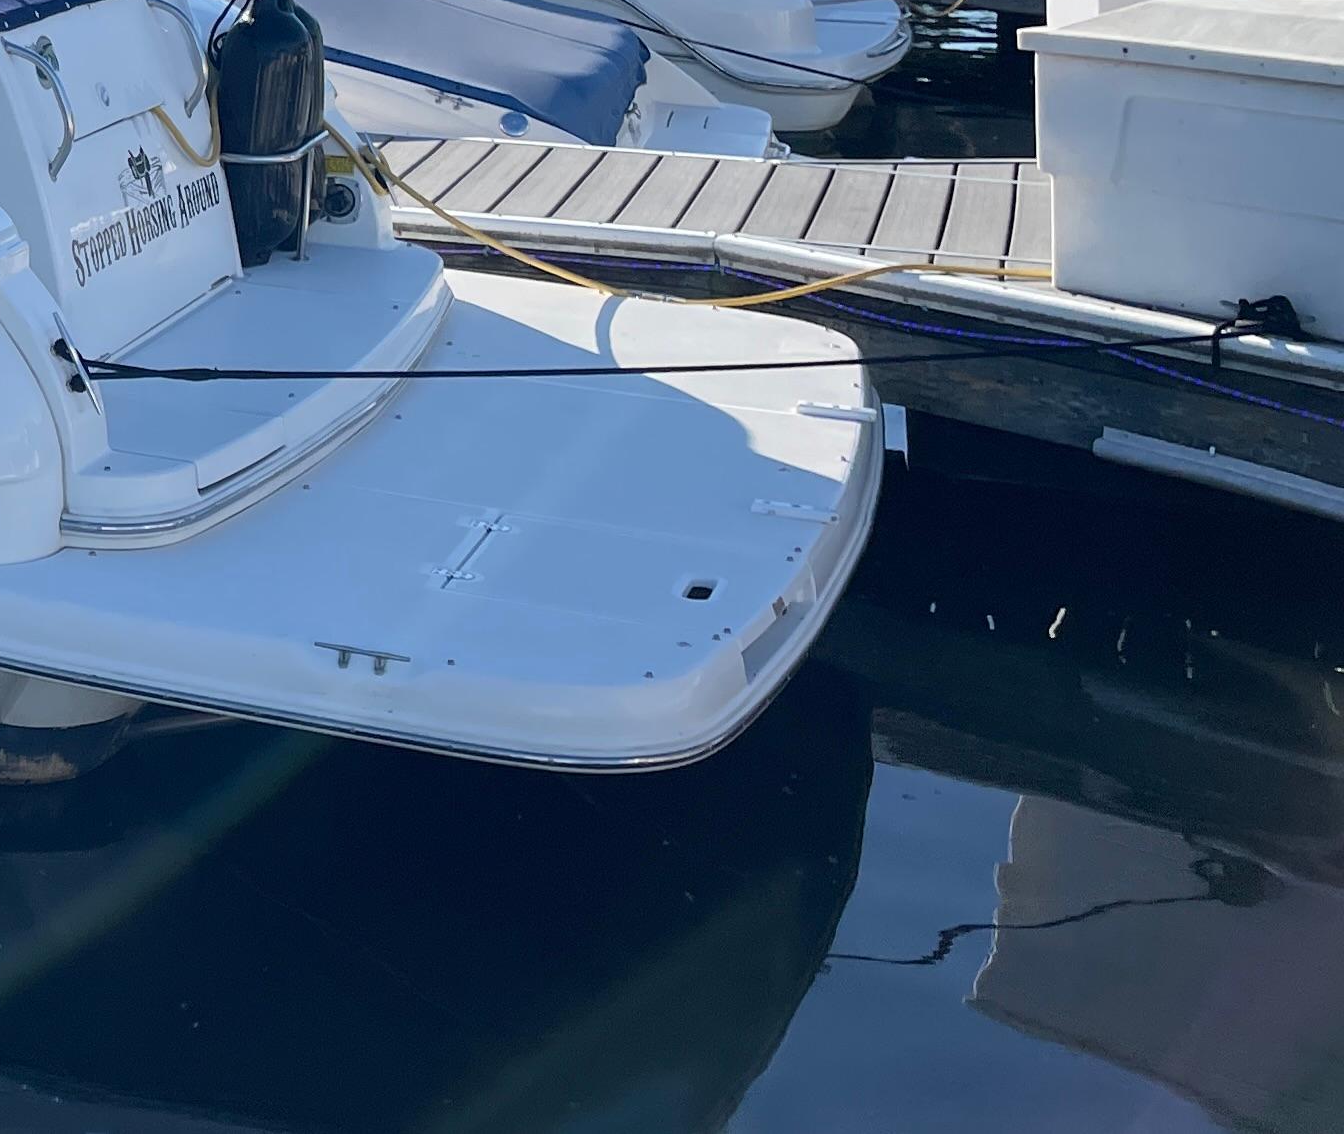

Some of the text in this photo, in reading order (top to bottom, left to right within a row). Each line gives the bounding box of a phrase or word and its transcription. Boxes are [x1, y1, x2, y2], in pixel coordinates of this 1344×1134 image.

[71, 171, 221, 288] STOPPED HORSING AROUND
